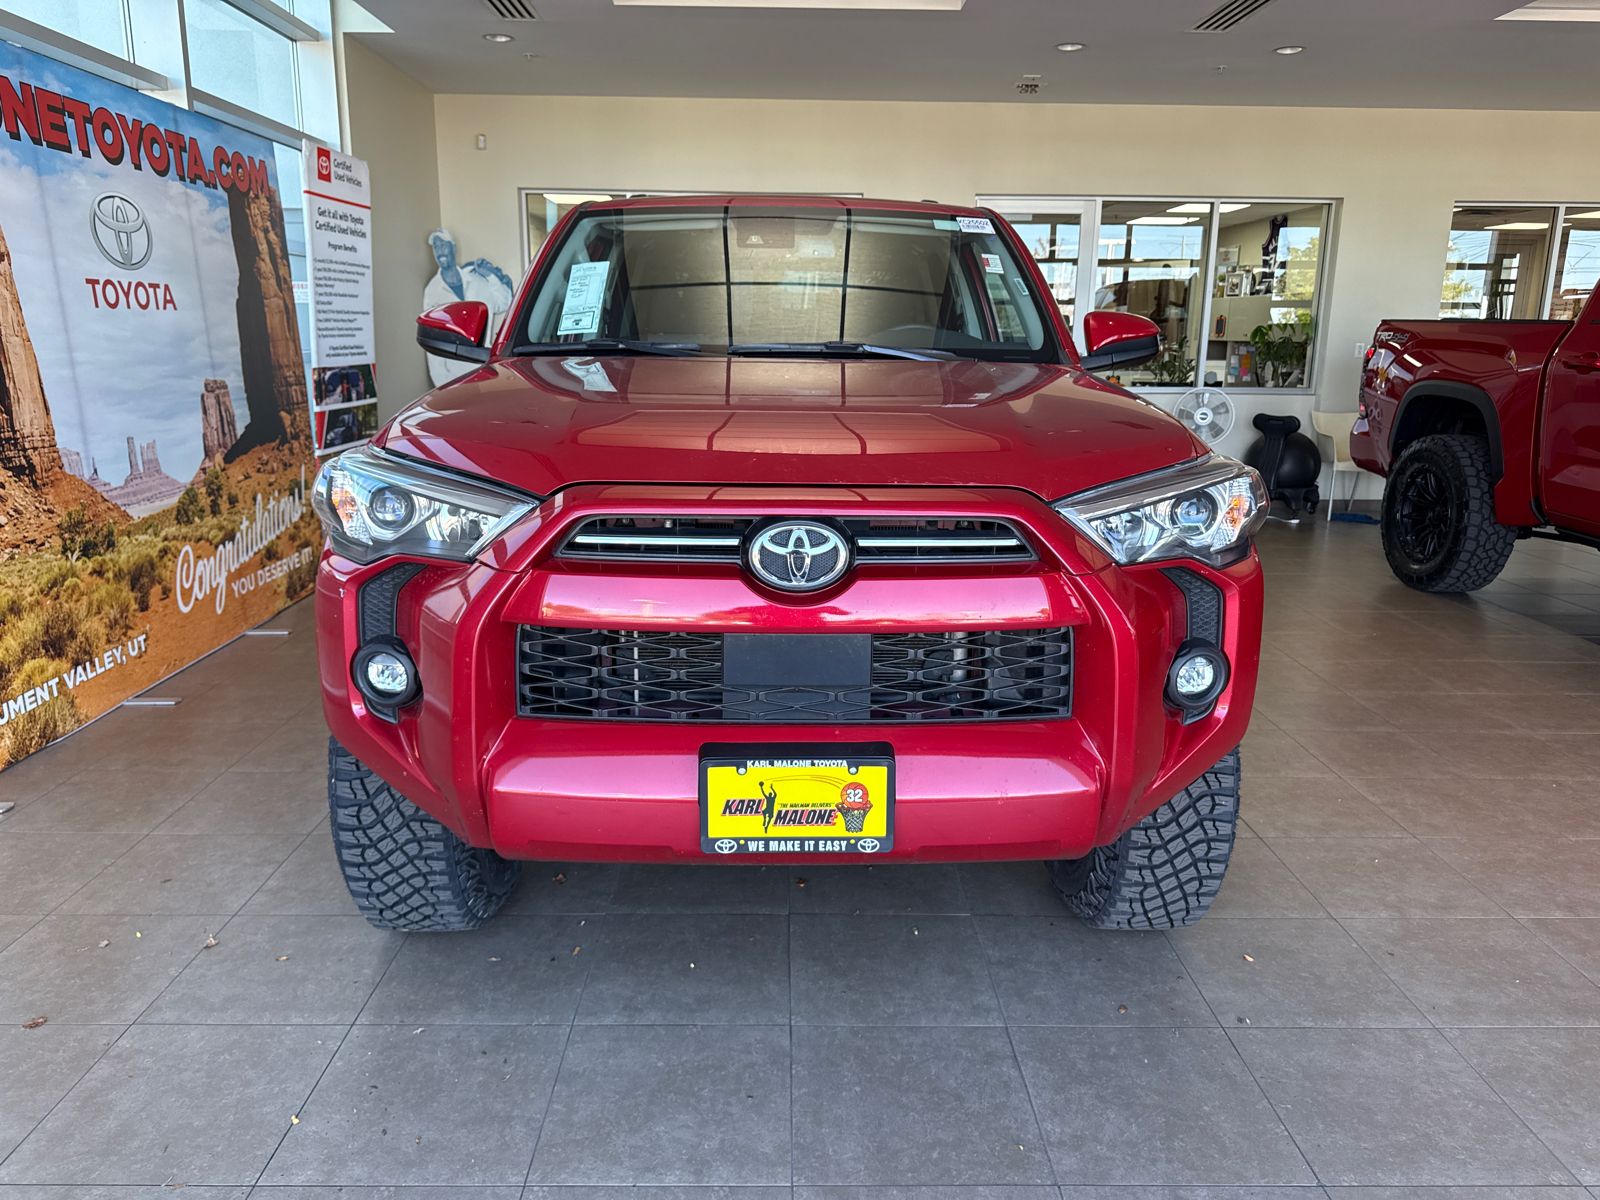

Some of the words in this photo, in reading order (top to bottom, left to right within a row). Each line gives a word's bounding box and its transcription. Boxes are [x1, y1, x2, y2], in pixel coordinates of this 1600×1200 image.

[0, 74, 270, 197] NETOYOTA.COM
[333, 158, 352, 173] Certified
[334, 171, 345, 182] Used
[345, 173, 362, 188] Vehicles
[317, 206, 327, 217] Get
[339, 211, 349, 222] with
[349, 213, 364, 226] Toyota
[315, 220, 337, 233] Certified
[337, 224, 349, 236] Used
[349, 225, 367, 239] Vehicles
[84, 277, 178, 311] TOYOTA
[176, 464, 306, 615] Congratulations!
[231, 573, 255, 598] YOU
[257, 552, 300, 587] DESERVE
[301, 546, 313, 565] IT!
[0, 676, 60, 726] UMENT
[62, 645, 127, 690] VALLEY,
[127, 633, 147, 657] UT
[747, 760, 771, 768] KARL
[773, 760, 811, 768] MALONE
[813, 760, 848, 768] TOYOTA
[846, 789, 863, 803] 32
[721, 798, 764, 816] KARL
[772, 808, 838, 827] MALONE
[747, 840, 765, 852] WE
[769, 840, 801, 852] MAKE
[804, 840, 815, 852] IT
[818, 840, 847, 852] EASY
